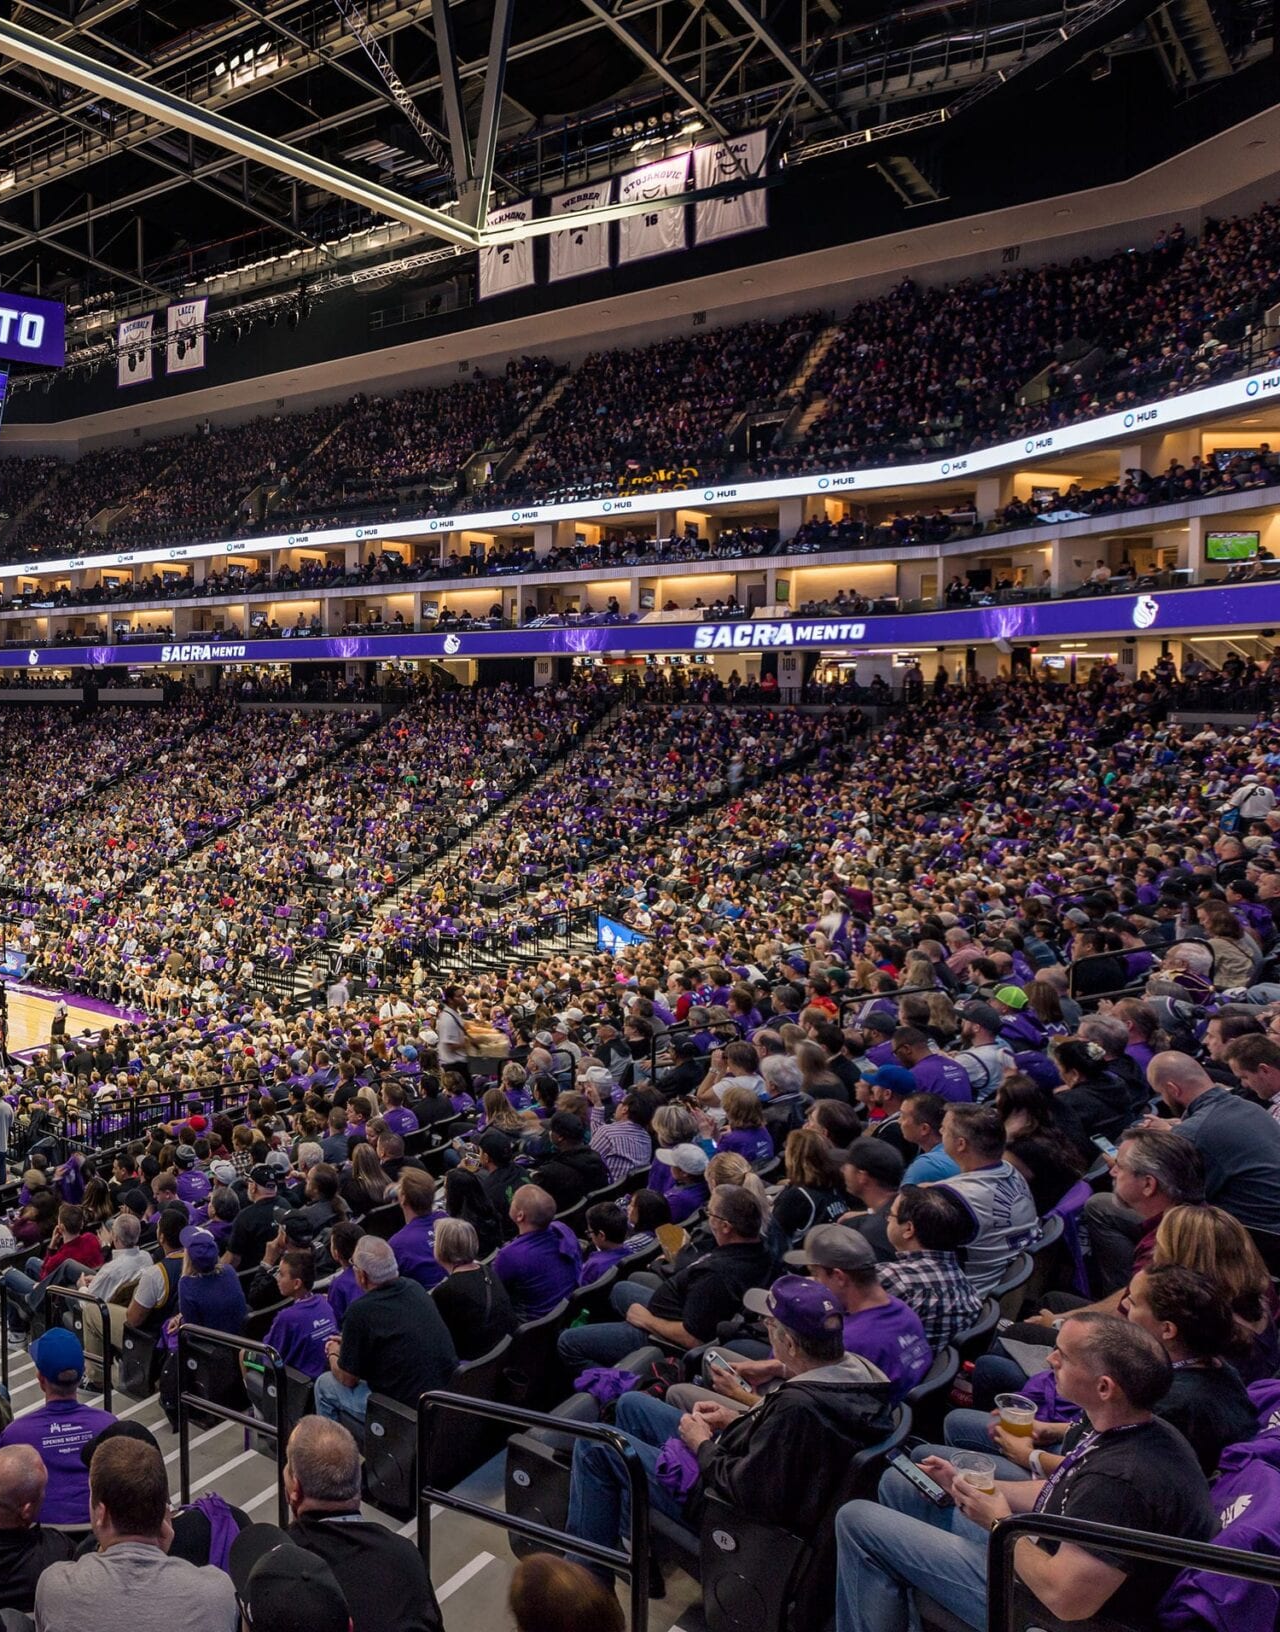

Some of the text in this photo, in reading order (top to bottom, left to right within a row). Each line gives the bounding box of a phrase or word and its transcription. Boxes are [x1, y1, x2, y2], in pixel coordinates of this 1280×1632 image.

[623, 170, 682, 194] STOJAKOVIC
[562, 191, 600, 210] WEBBER
[645, 213, 658, 227] 16
[575, 234, 583, 246] 4
[502, 253, 510, 264] 2
[178, 305, 196, 316] LACEY
[1262, 377, 1280, 391] HU
[1136, 409, 1158, 422] HUB
[1035, 438, 1053, 449] HUB
[952, 461, 968, 471] HUB
[832, 477, 855, 486] HUB
[716, 490, 737, 499] HUB
[614, 502, 632, 510] HUB
[694, 623, 865, 648] SACRAMENTO
[160, 645, 246, 662] SACRAMENTO
[537, 662, 549, 674] 108
[782, 658, 796, 671] 109
[42, 1437, 65, 1446] OPENING
